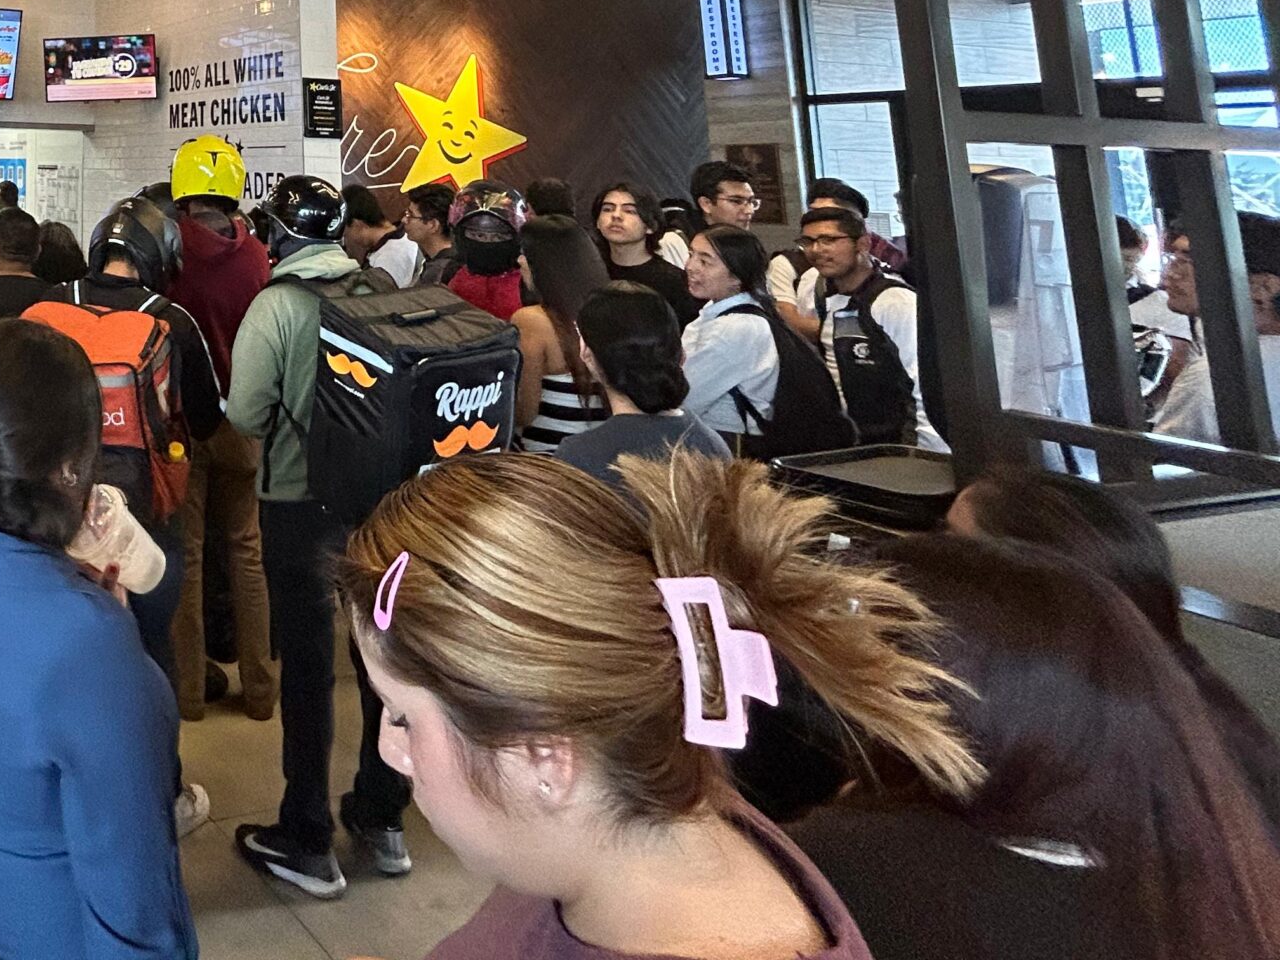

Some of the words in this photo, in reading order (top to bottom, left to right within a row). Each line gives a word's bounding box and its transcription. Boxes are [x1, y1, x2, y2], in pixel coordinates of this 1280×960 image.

[707, 0, 720, 72] RESTROOMS
[169, 65, 201, 92] 100%
[205, 60, 230, 88] ALL
[233, 51, 284, 84] WHITE
[169, 101, 207, 129] MEAT
[210, 92, 286, 127] CHICKEN
[435, 371, 504, 422] Rappi
